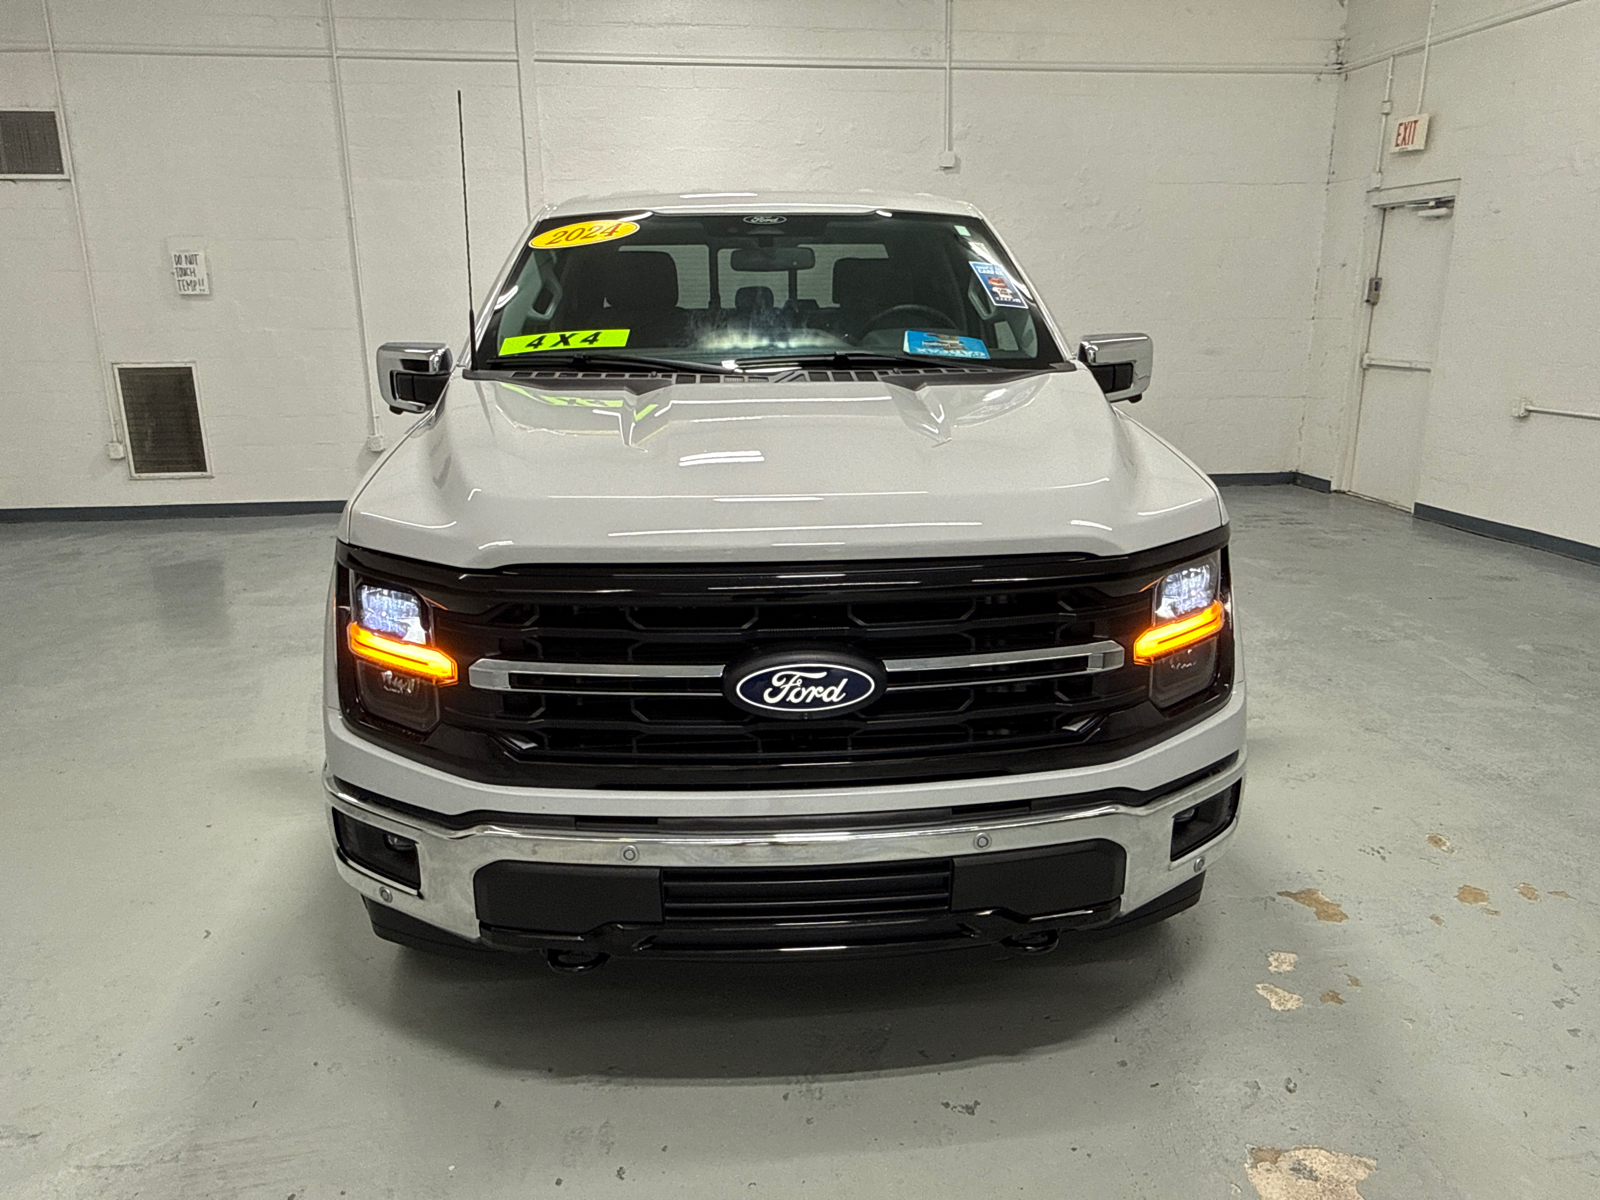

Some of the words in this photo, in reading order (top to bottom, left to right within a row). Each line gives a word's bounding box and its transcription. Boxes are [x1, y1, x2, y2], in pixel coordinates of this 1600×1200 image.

[1395, 119, 1419, 148] EXIT
[545, 222, 622, 246] 2024
[173, 254, 183, 266] DO
[184, 253, 199, 266] NOT
[174, 267, 197, 278] TOUCH
[763, 670, 849, 704] Ford
